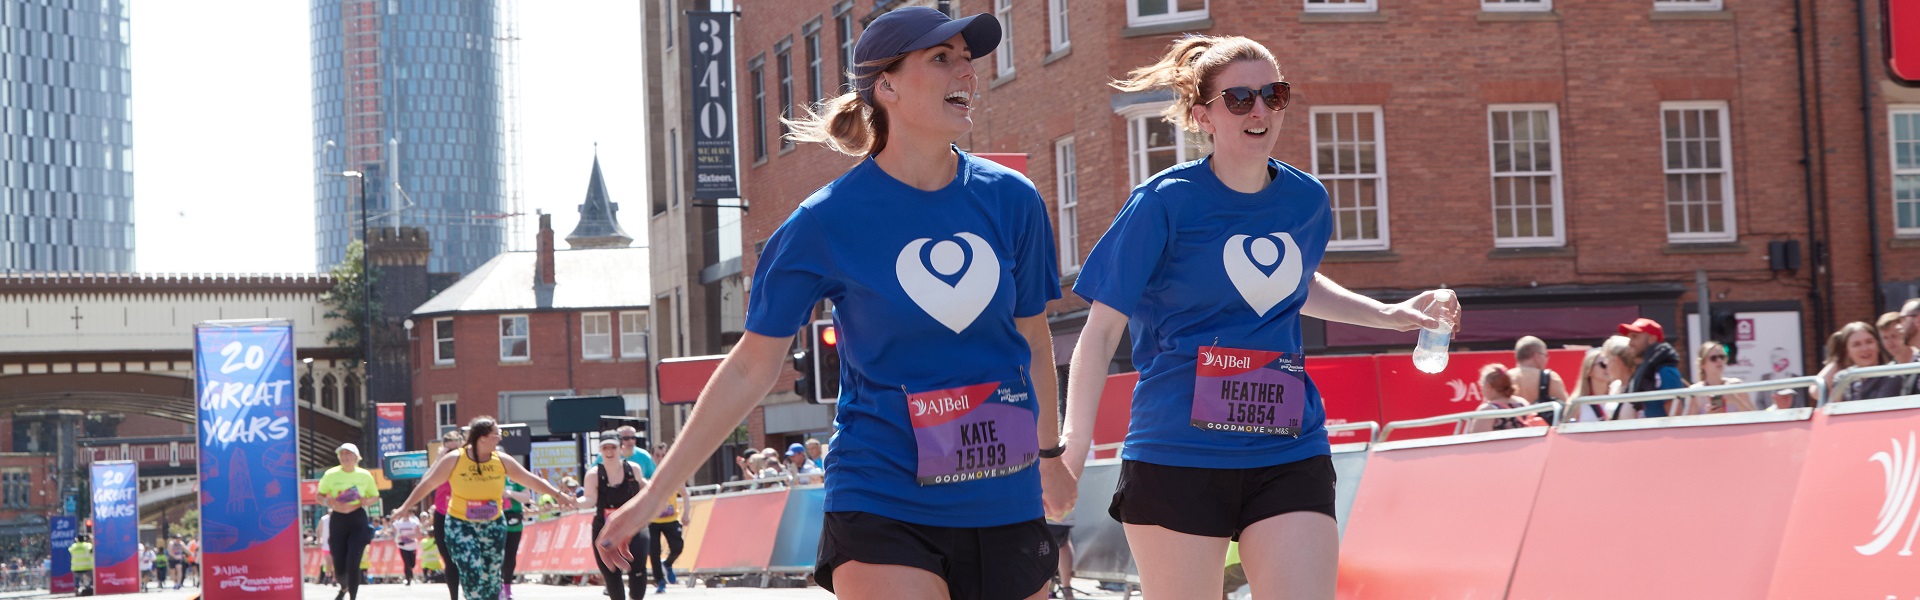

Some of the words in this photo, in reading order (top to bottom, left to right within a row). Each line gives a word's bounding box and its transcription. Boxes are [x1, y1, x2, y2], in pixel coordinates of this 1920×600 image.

[699, 19, 727, 138] 340
[220, 341, 264, 374] 20
[1221, 380, 1285, 404] HEATHER
[1227, 403, 1275, 425] 15854
[960, 420, 998, 446] KATE
[1207, 422, 1264, 433] GOODMOVE
[1275, 427, 1289, 435] M&S
[393, 460, 411, 469] AQUA
[956, 444, 1006, 471] 15193
[102, 470, 125, 486] 20
[935, 469, 997, 483] GOODMOVE
